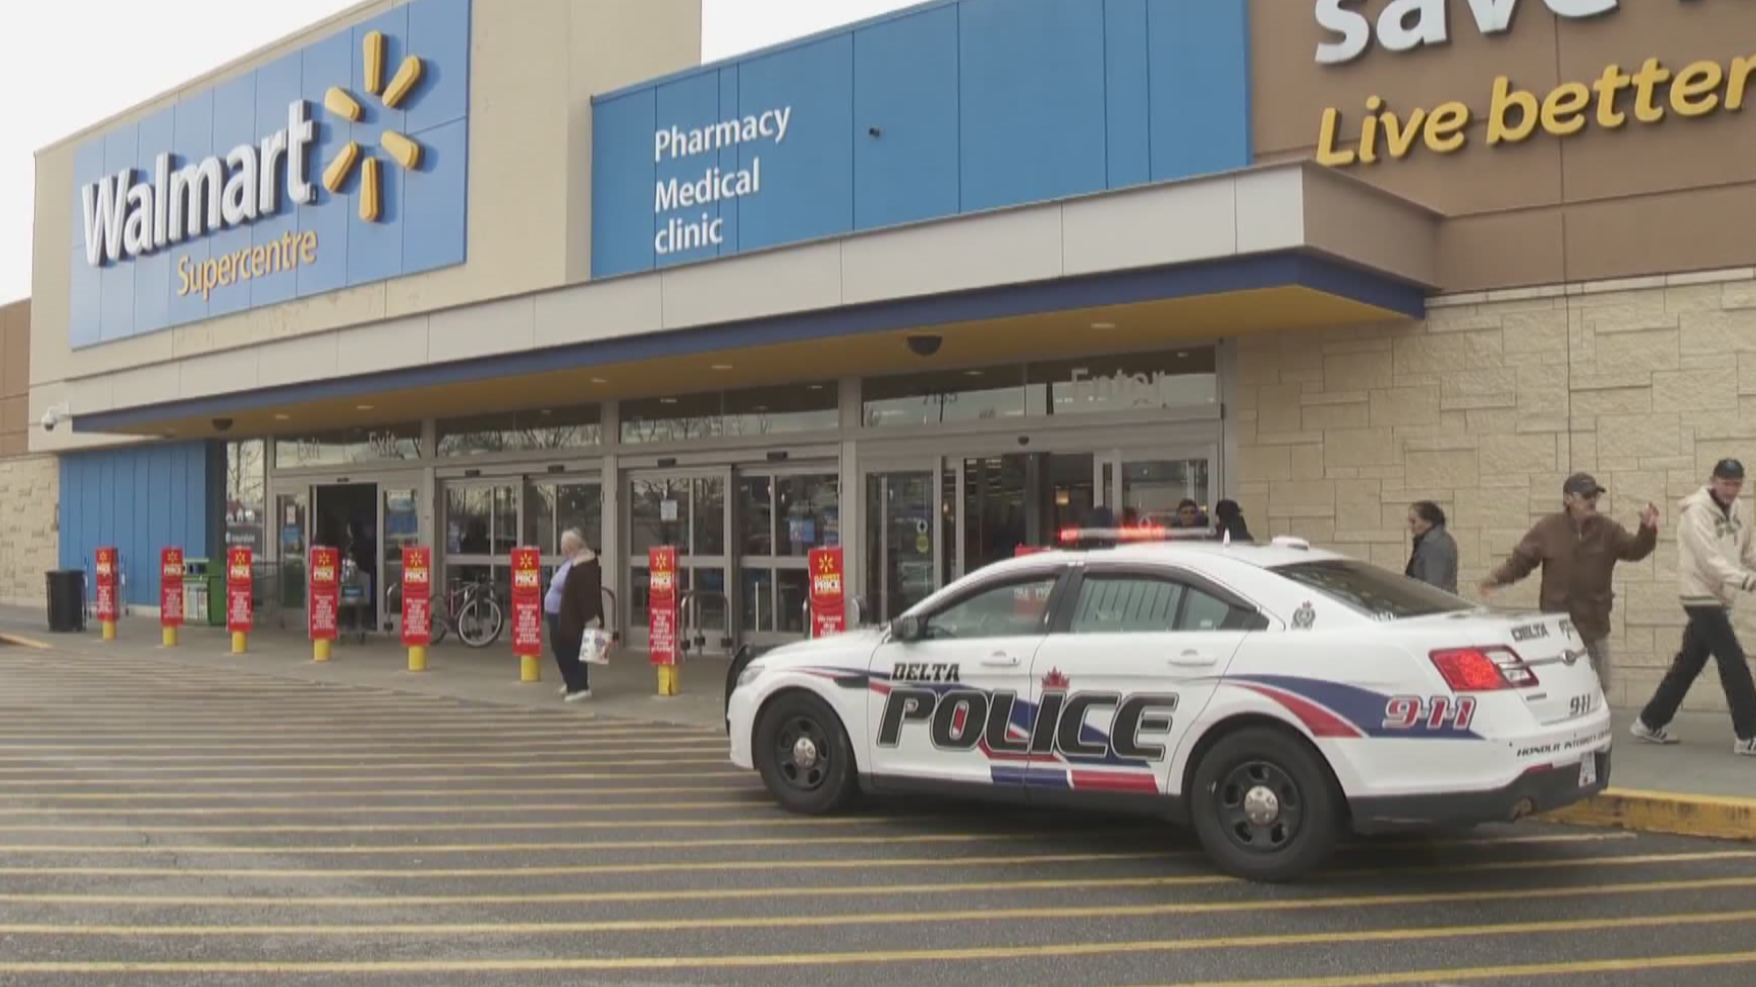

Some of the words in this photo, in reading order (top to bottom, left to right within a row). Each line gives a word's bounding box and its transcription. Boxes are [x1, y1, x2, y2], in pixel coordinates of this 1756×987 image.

[654, 105, 791, 163] Pharmacy
[1315, 95, 1469, 166] Live
[1487, 56, 1756, 145] better
[82, 99, 317, 267] Walmart
[654, 158, 760, 213] Medical
[654, 215, 723, 255] clinic
[177, 229, 318, 300] Supercentre
[1072, 367, 1165, 405] Enter
[815, 581, 841, 594] PRICE
[1511, 622, 1549, 643] DELTA
[891, 662, 960, 682] DELTA
[876, 686, 1180, 762] POLICE
